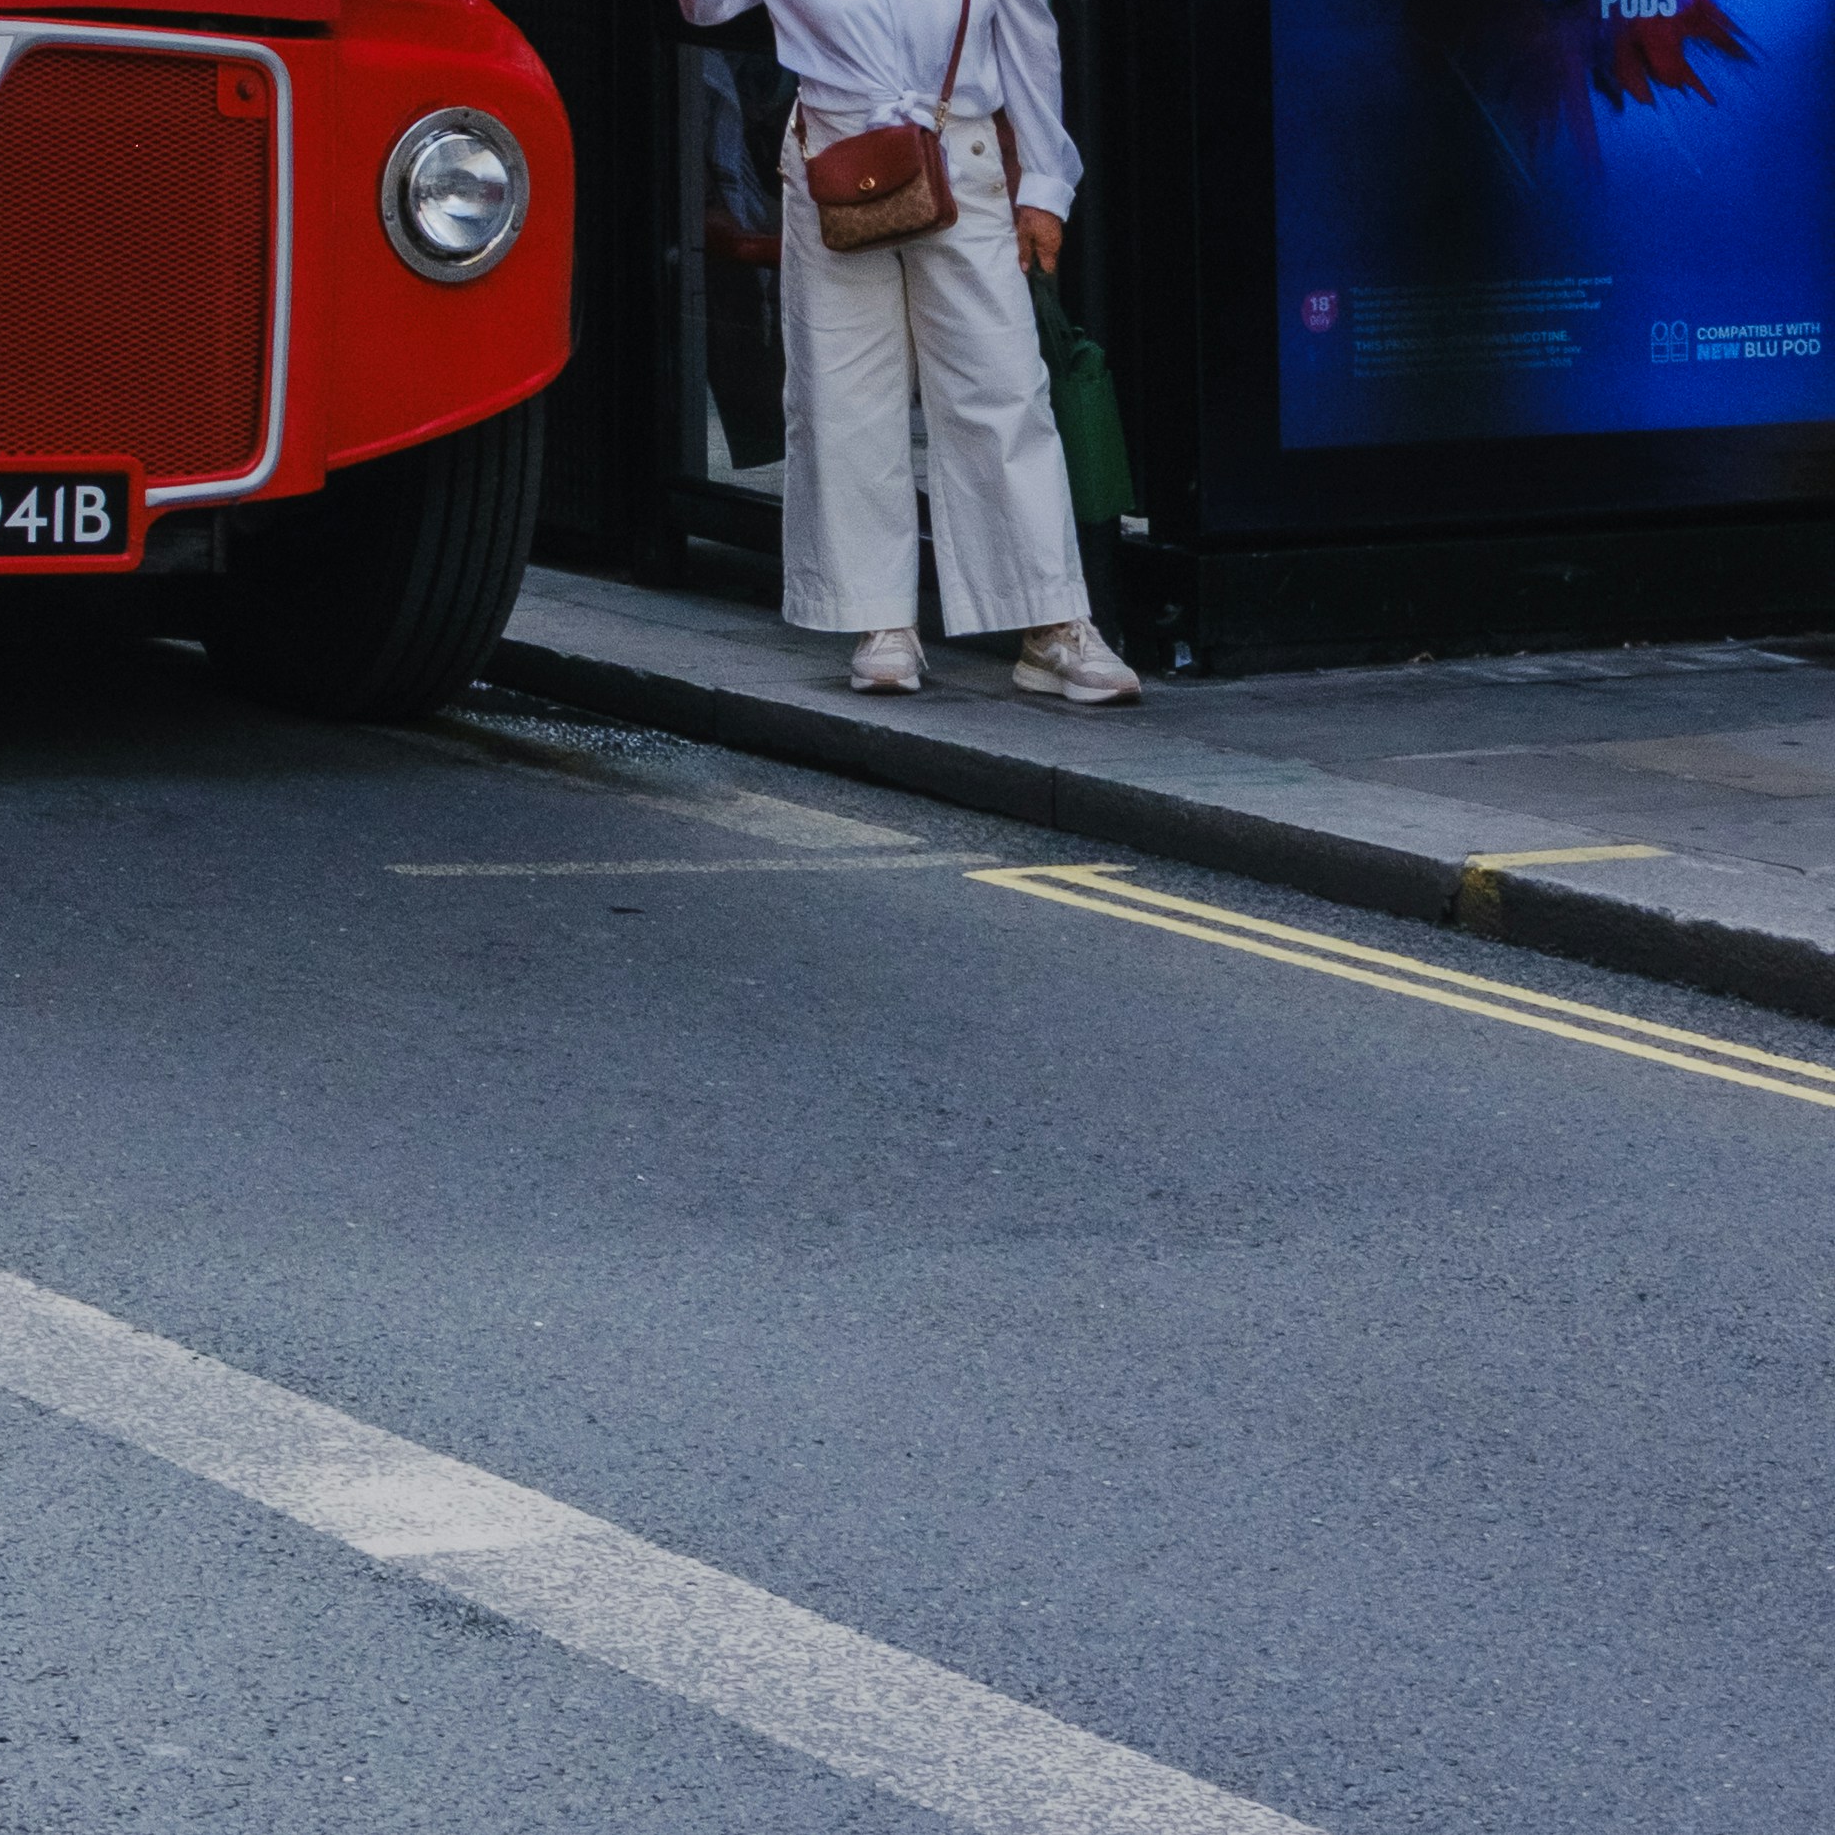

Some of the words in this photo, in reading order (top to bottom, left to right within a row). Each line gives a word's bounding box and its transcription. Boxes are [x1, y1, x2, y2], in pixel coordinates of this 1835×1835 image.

[1696, 325, 1782, 340] COMPATIBLE
[1786, 322, 1821, 336] WITH
[1696, 343, 1740, 360] NEW
[1744, 340, 1779, 358] BLU
[1782, 338, 1822, 356] POD
